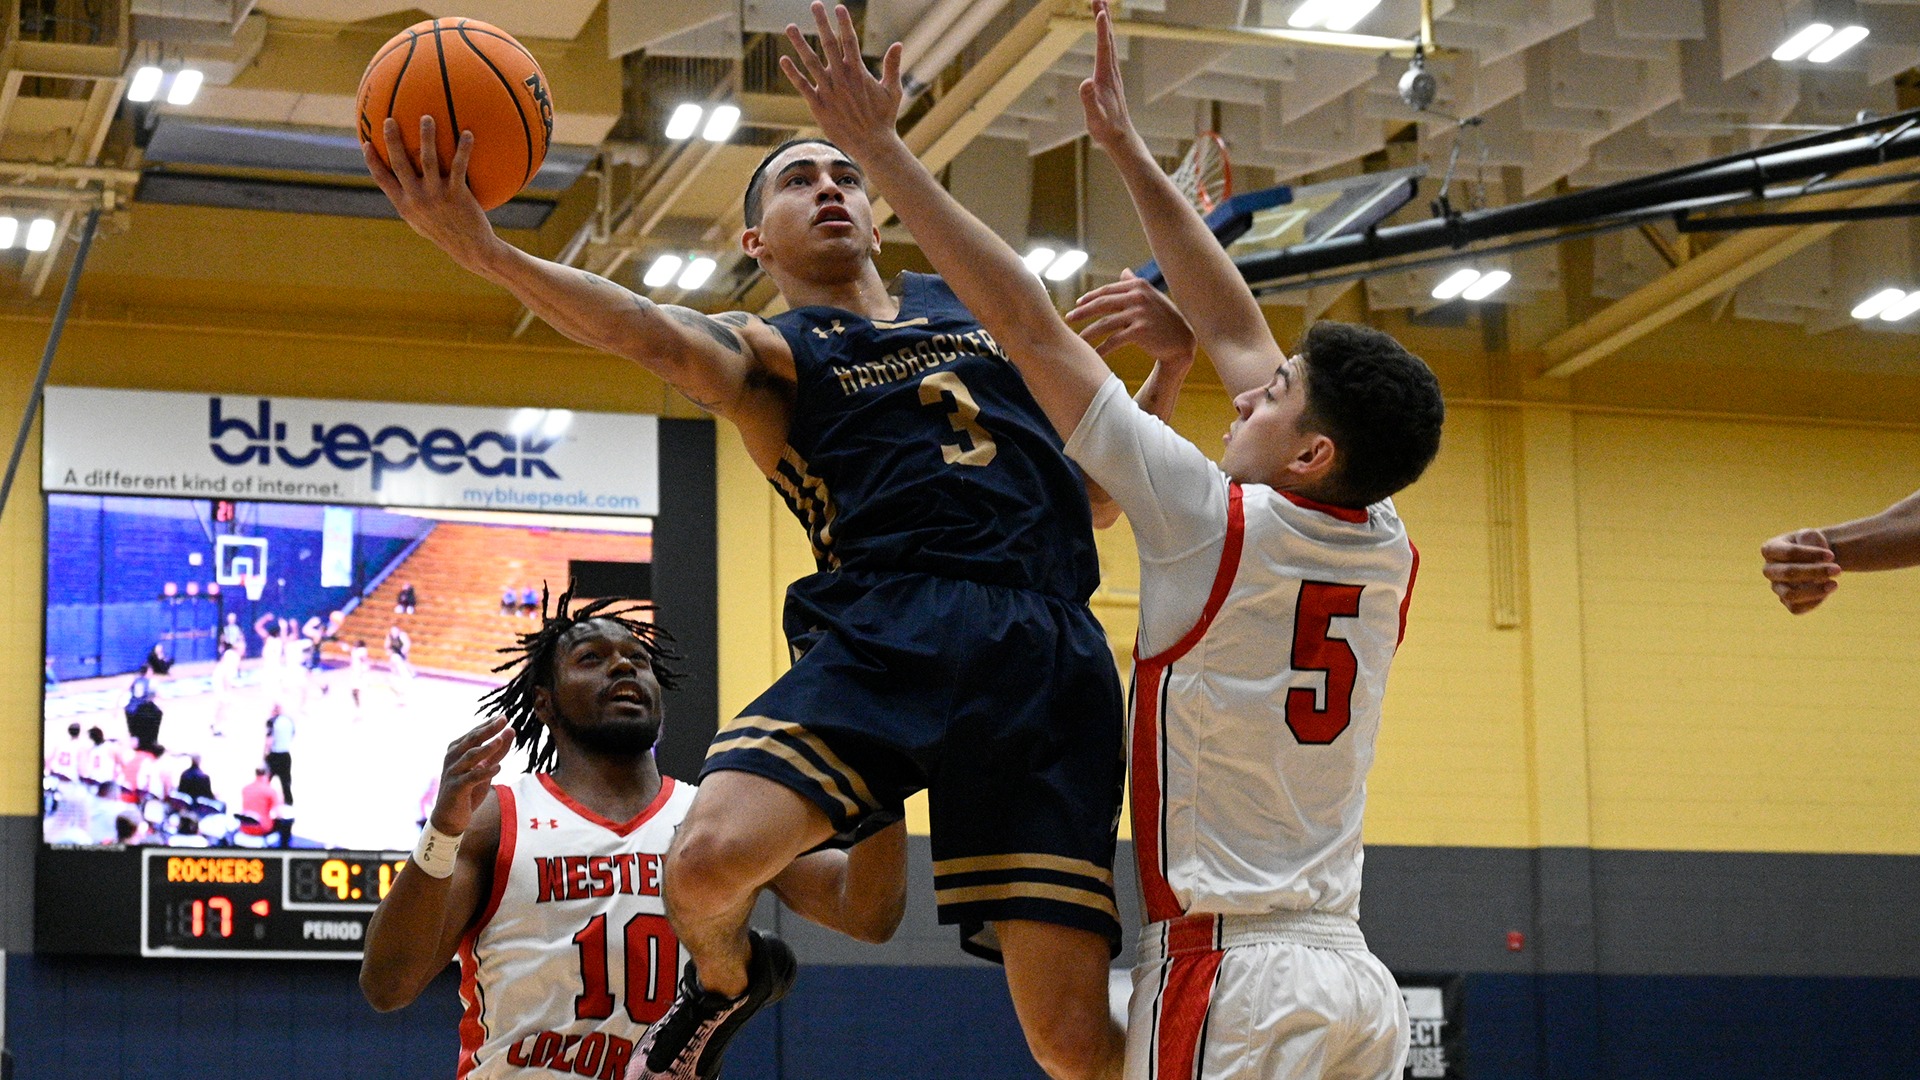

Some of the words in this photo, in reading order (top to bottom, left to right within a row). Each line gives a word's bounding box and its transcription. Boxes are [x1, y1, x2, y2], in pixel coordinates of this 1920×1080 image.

[918, 371, 997, 467] 3
[209, 397, 562, 491] bluepeak
[64, 469, 78, 485] A
[84, 470, 177, 489] different
[182, 473, 226, 493] kind
[232, 477, 251, 494] of
[258, 478, 344, 498] internet.
[463, 485, 640, 509] mybluepeak.com
[1284, 579, 1367, 745] 5
[167, 857, 264, 884] ROCKERS
[321, 859, 406, 901] 9:1
[534, 852, 668, 904] WESTE
[191, 896, 233, 938] 17
[303, 920, 362, 941] PERIOD
[572, 912, 680, 1025] 10
